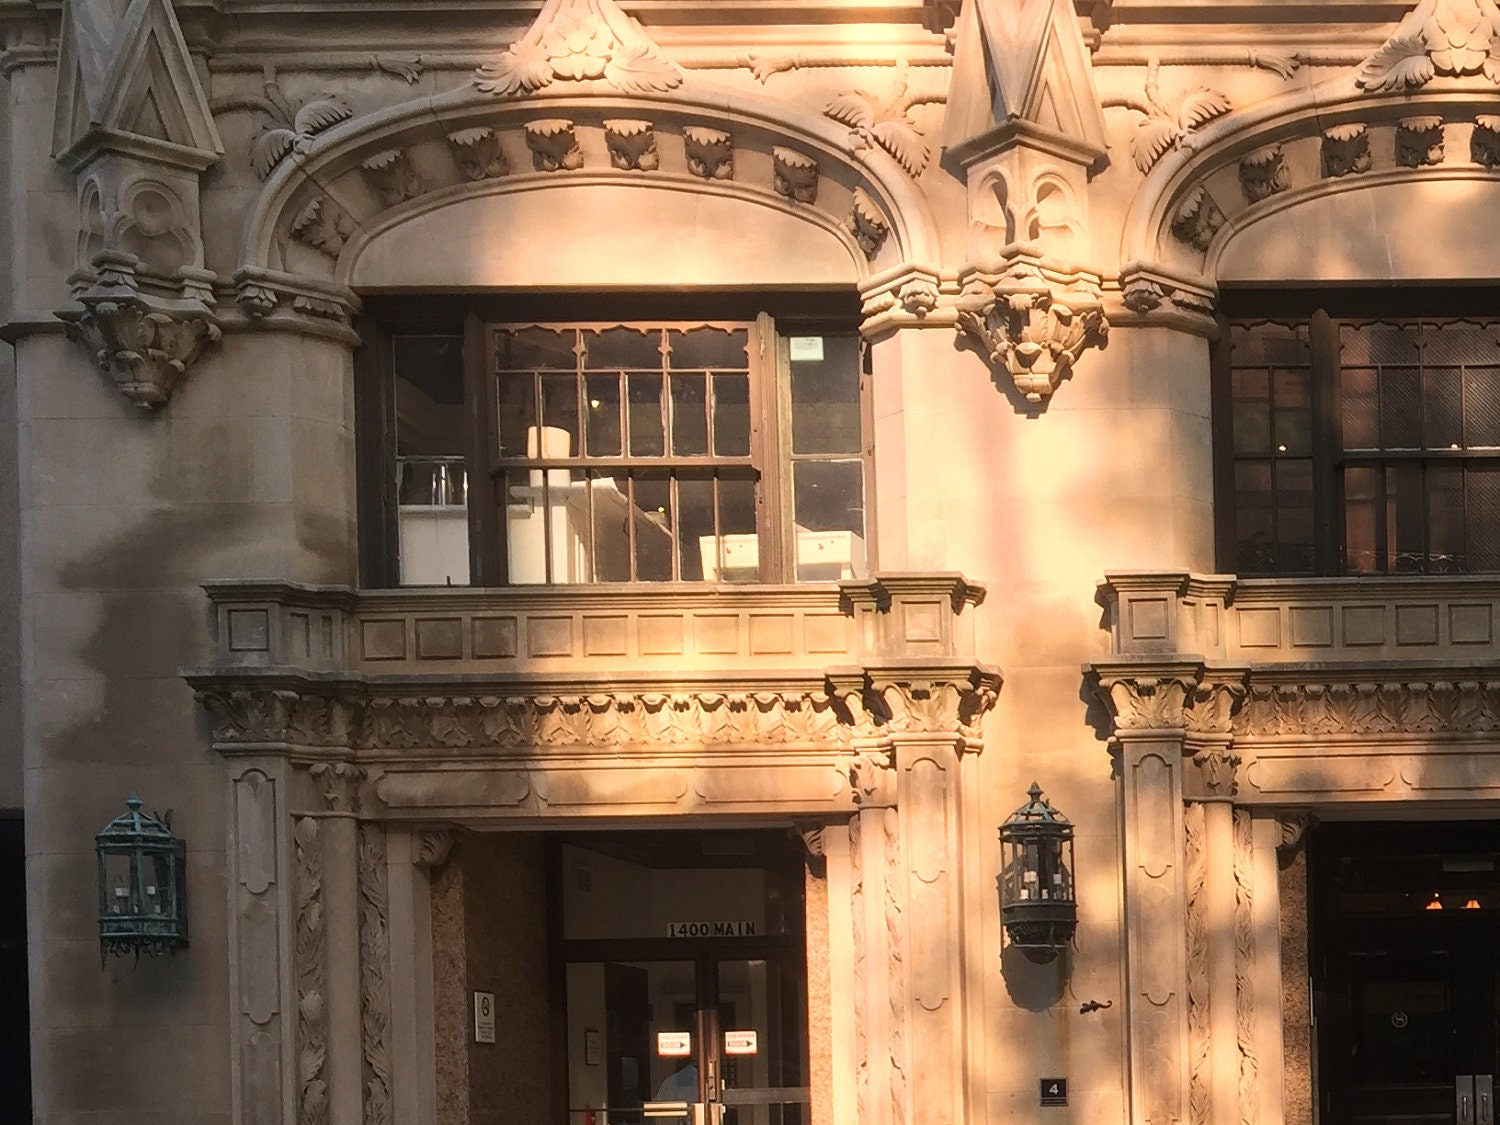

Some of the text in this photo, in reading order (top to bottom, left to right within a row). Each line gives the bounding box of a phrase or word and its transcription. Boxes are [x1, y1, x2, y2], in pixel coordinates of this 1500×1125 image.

[669, 922, 755, 937] 1400 MAIN
[1048, 1083, 1059, 1095] 4
